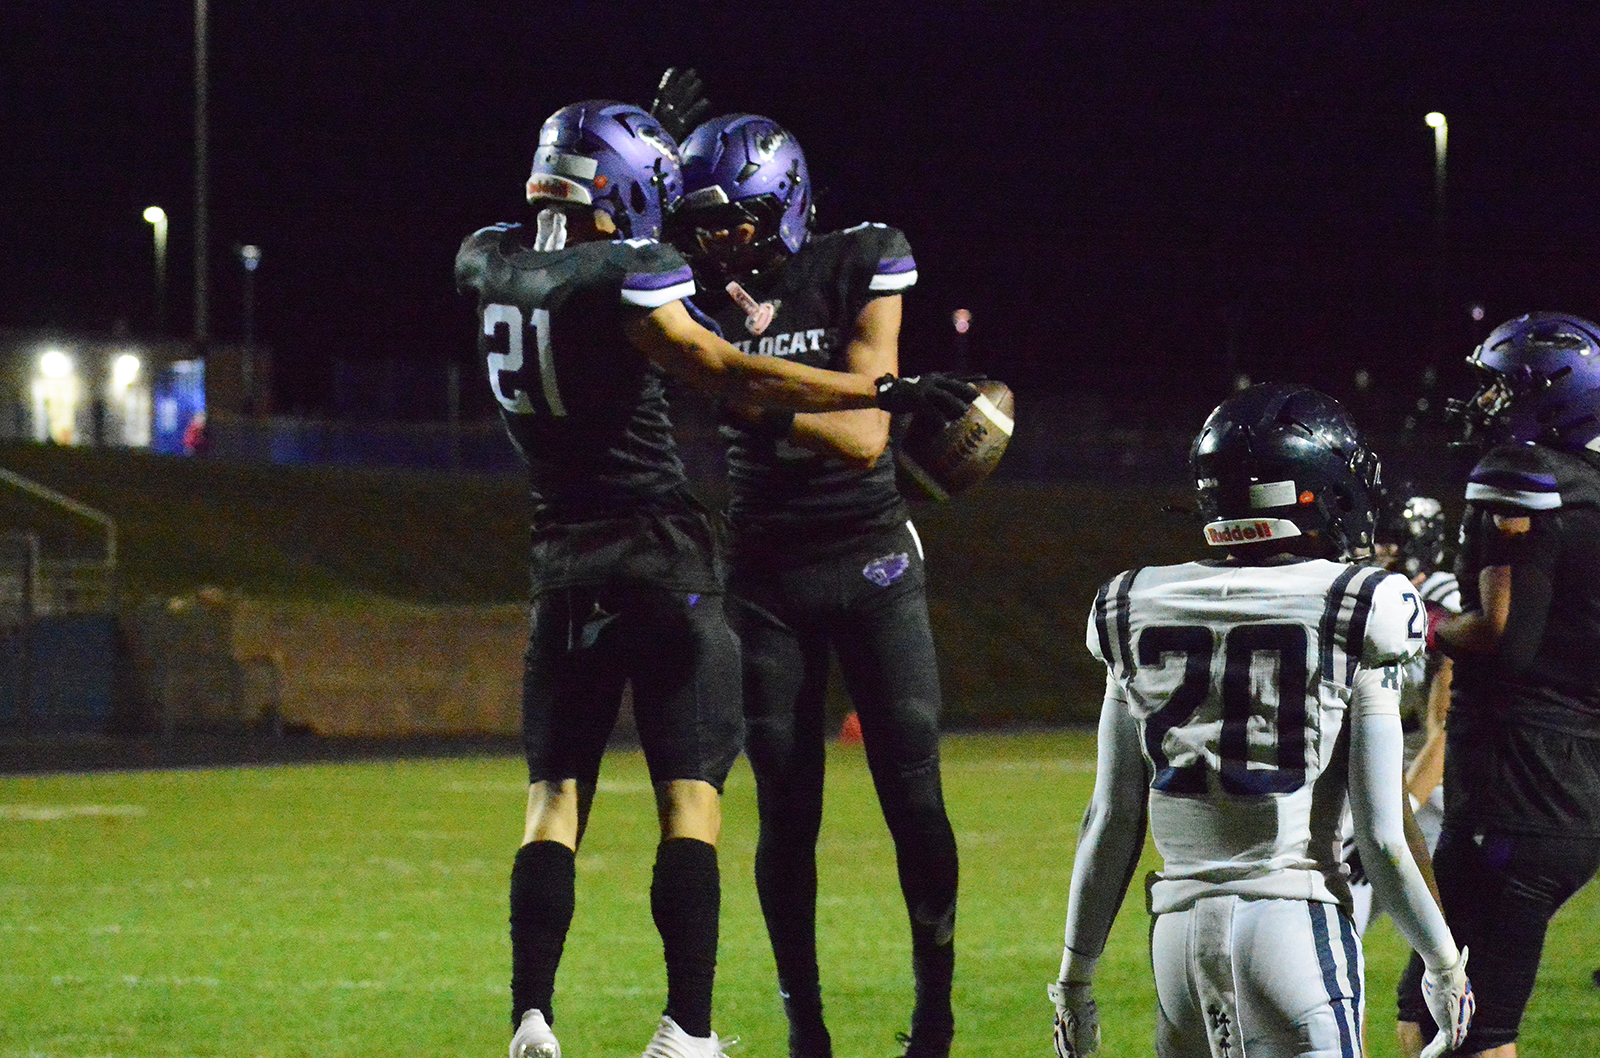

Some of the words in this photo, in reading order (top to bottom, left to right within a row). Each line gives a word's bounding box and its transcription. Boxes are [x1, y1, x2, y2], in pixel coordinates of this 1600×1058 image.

[484, 303, 567, 417] 21
[1207, 521, 1273, 543] Riddell
[1402, 592, 1426, 639] 2
[1138, 624, 1308, 795] 20
